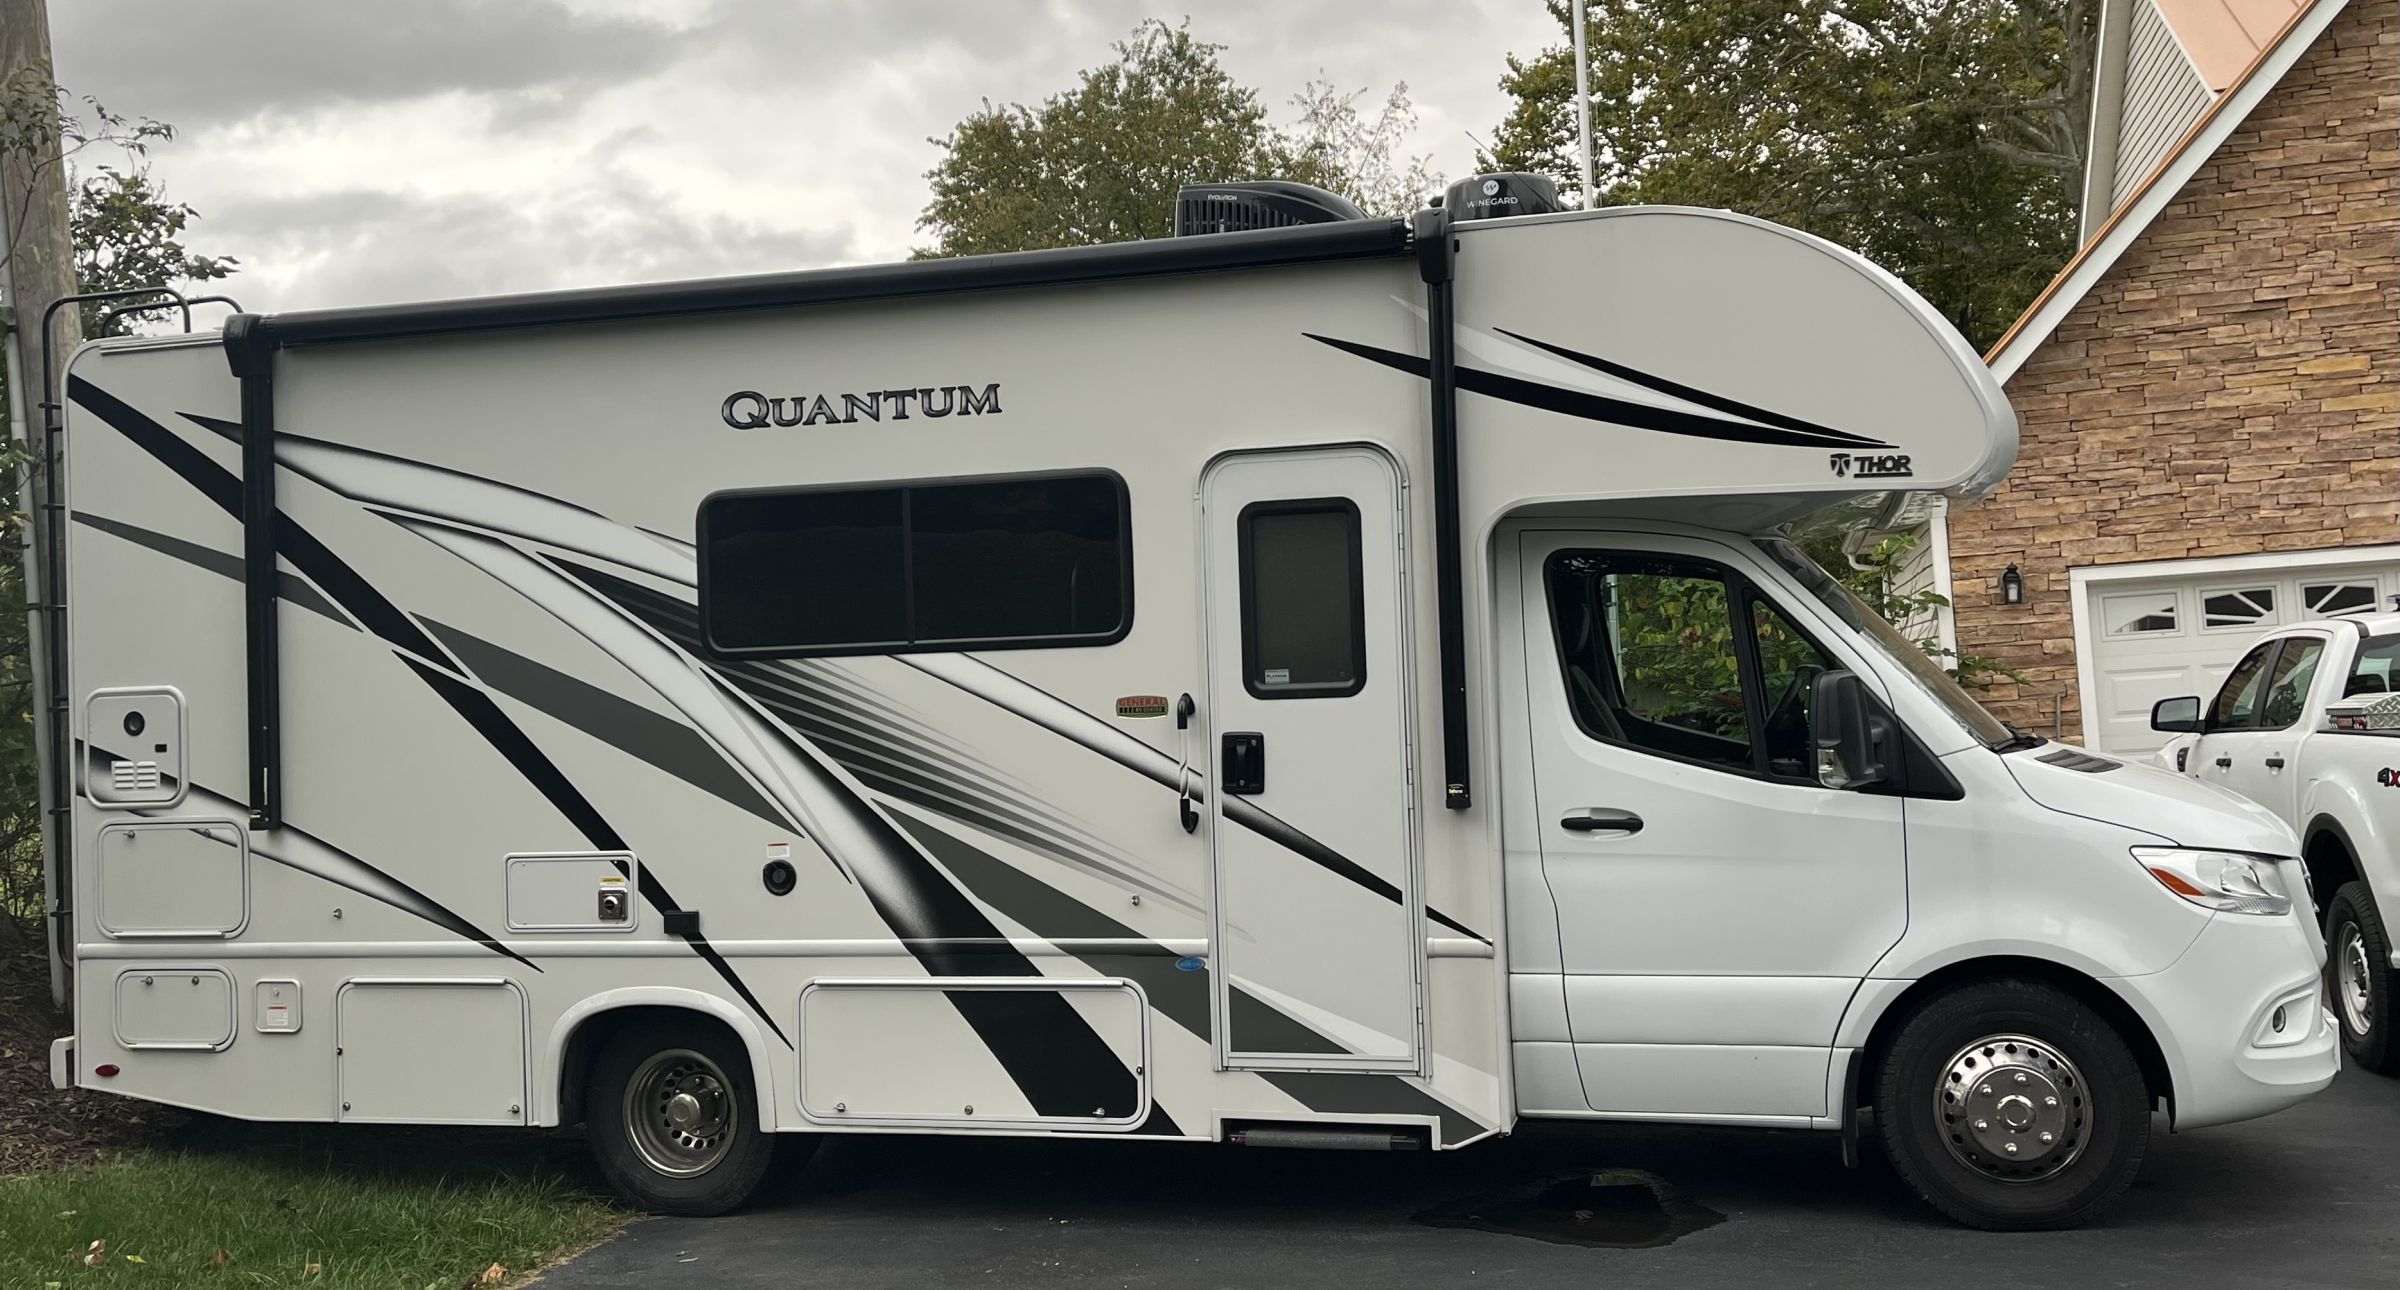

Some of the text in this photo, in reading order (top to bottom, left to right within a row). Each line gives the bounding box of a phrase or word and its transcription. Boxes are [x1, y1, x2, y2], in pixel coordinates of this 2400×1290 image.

[1466, 196, 1518, 208] WINEGARD
[721, 384, 1002, 430] QUANTUM
[1853, 455, 1912, 473] THOR
[1119, 698, 1164, 706] GENERAL
